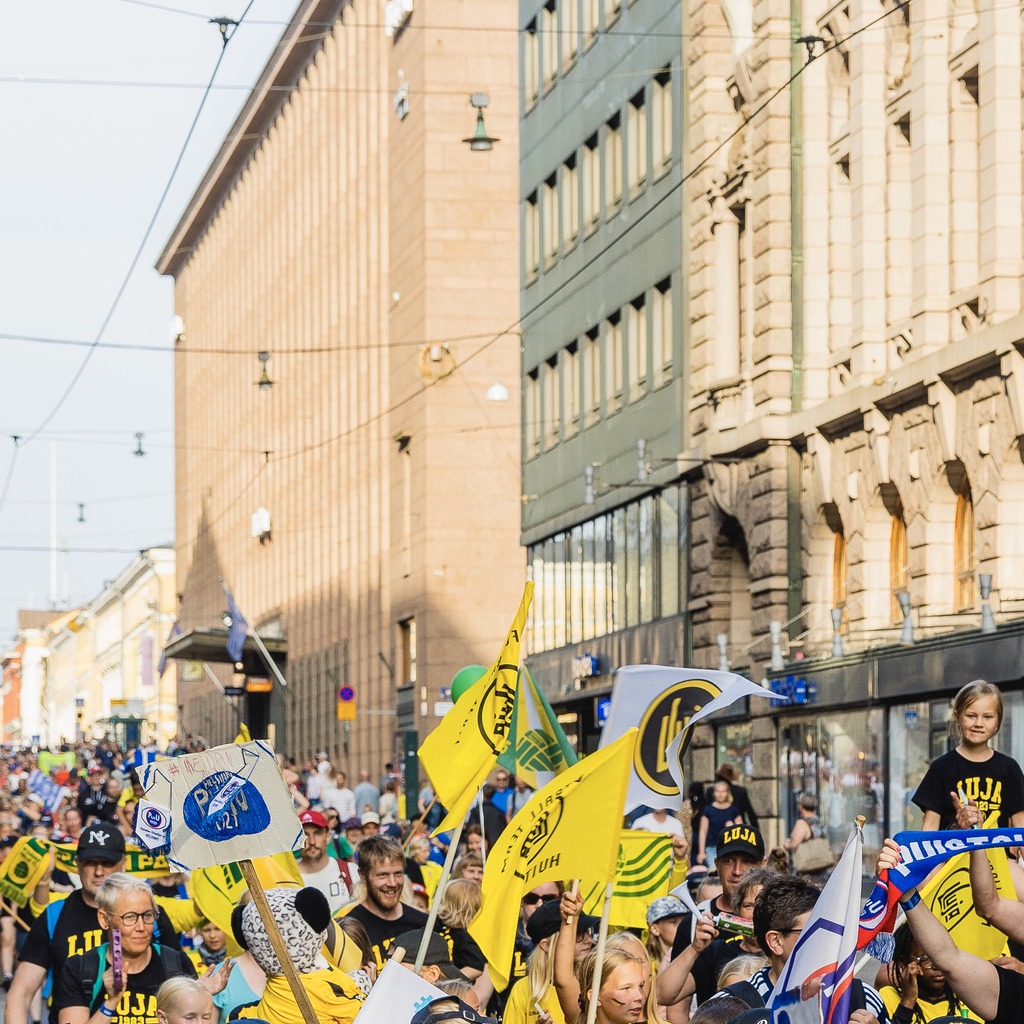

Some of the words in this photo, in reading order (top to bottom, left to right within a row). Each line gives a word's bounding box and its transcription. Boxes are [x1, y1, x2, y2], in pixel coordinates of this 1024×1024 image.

[88, 830, 110, 846] NY
[724, 826, 757, 846] LUJA
[104, 991, 157, 1018] UJA
